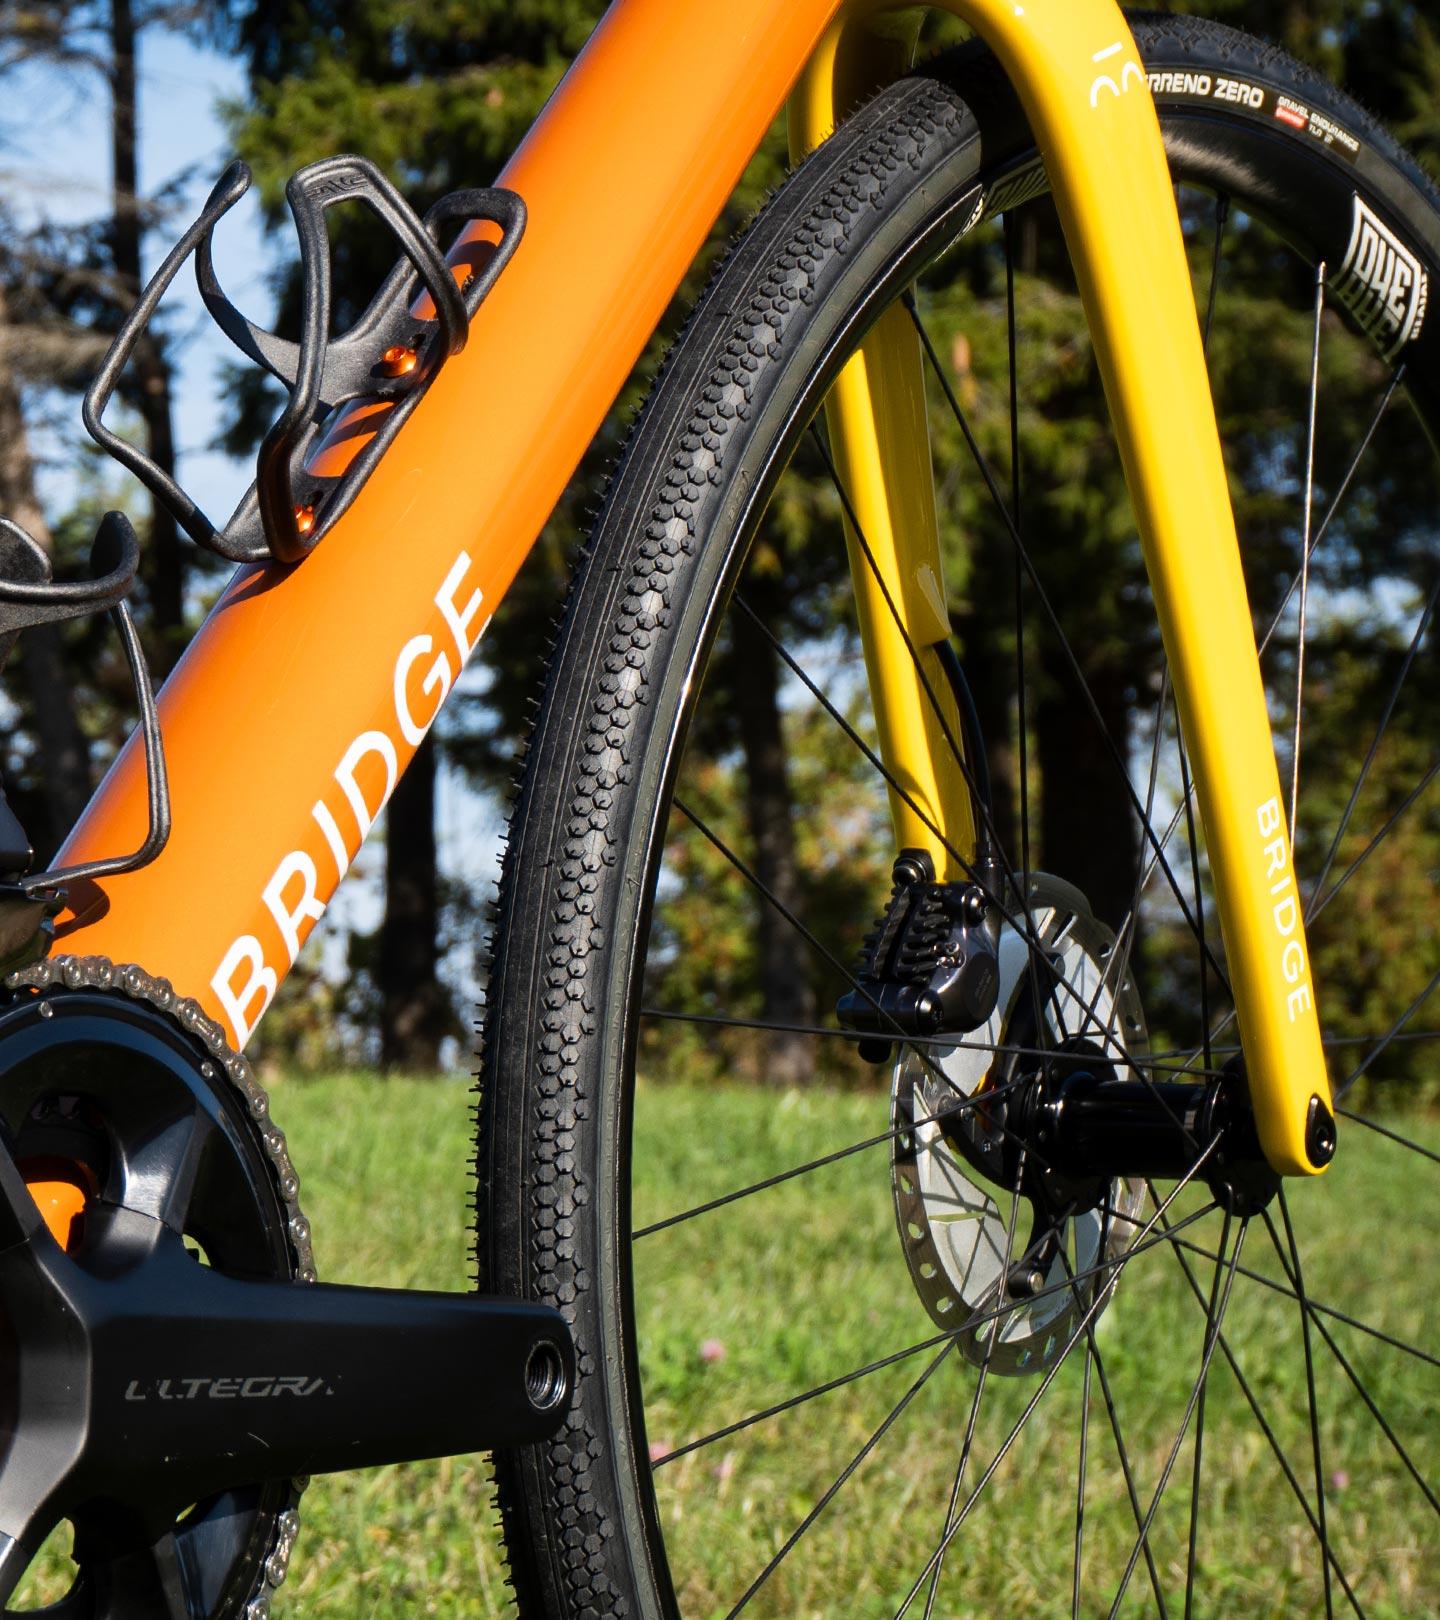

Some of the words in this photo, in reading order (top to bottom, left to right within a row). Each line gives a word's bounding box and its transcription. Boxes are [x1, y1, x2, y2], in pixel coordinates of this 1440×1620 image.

[1146, 73, 1211, 95] RRENO
[1213, 78, 1264, 108] ZERO
[1277, 95, 1309, 119] GRAVEL
[1310, 111, 1360, 152] ENDURANCE
[210, 550, 493, 1052] BRIDGE
[1257, 796, 1311, 1023] BRIDGE
